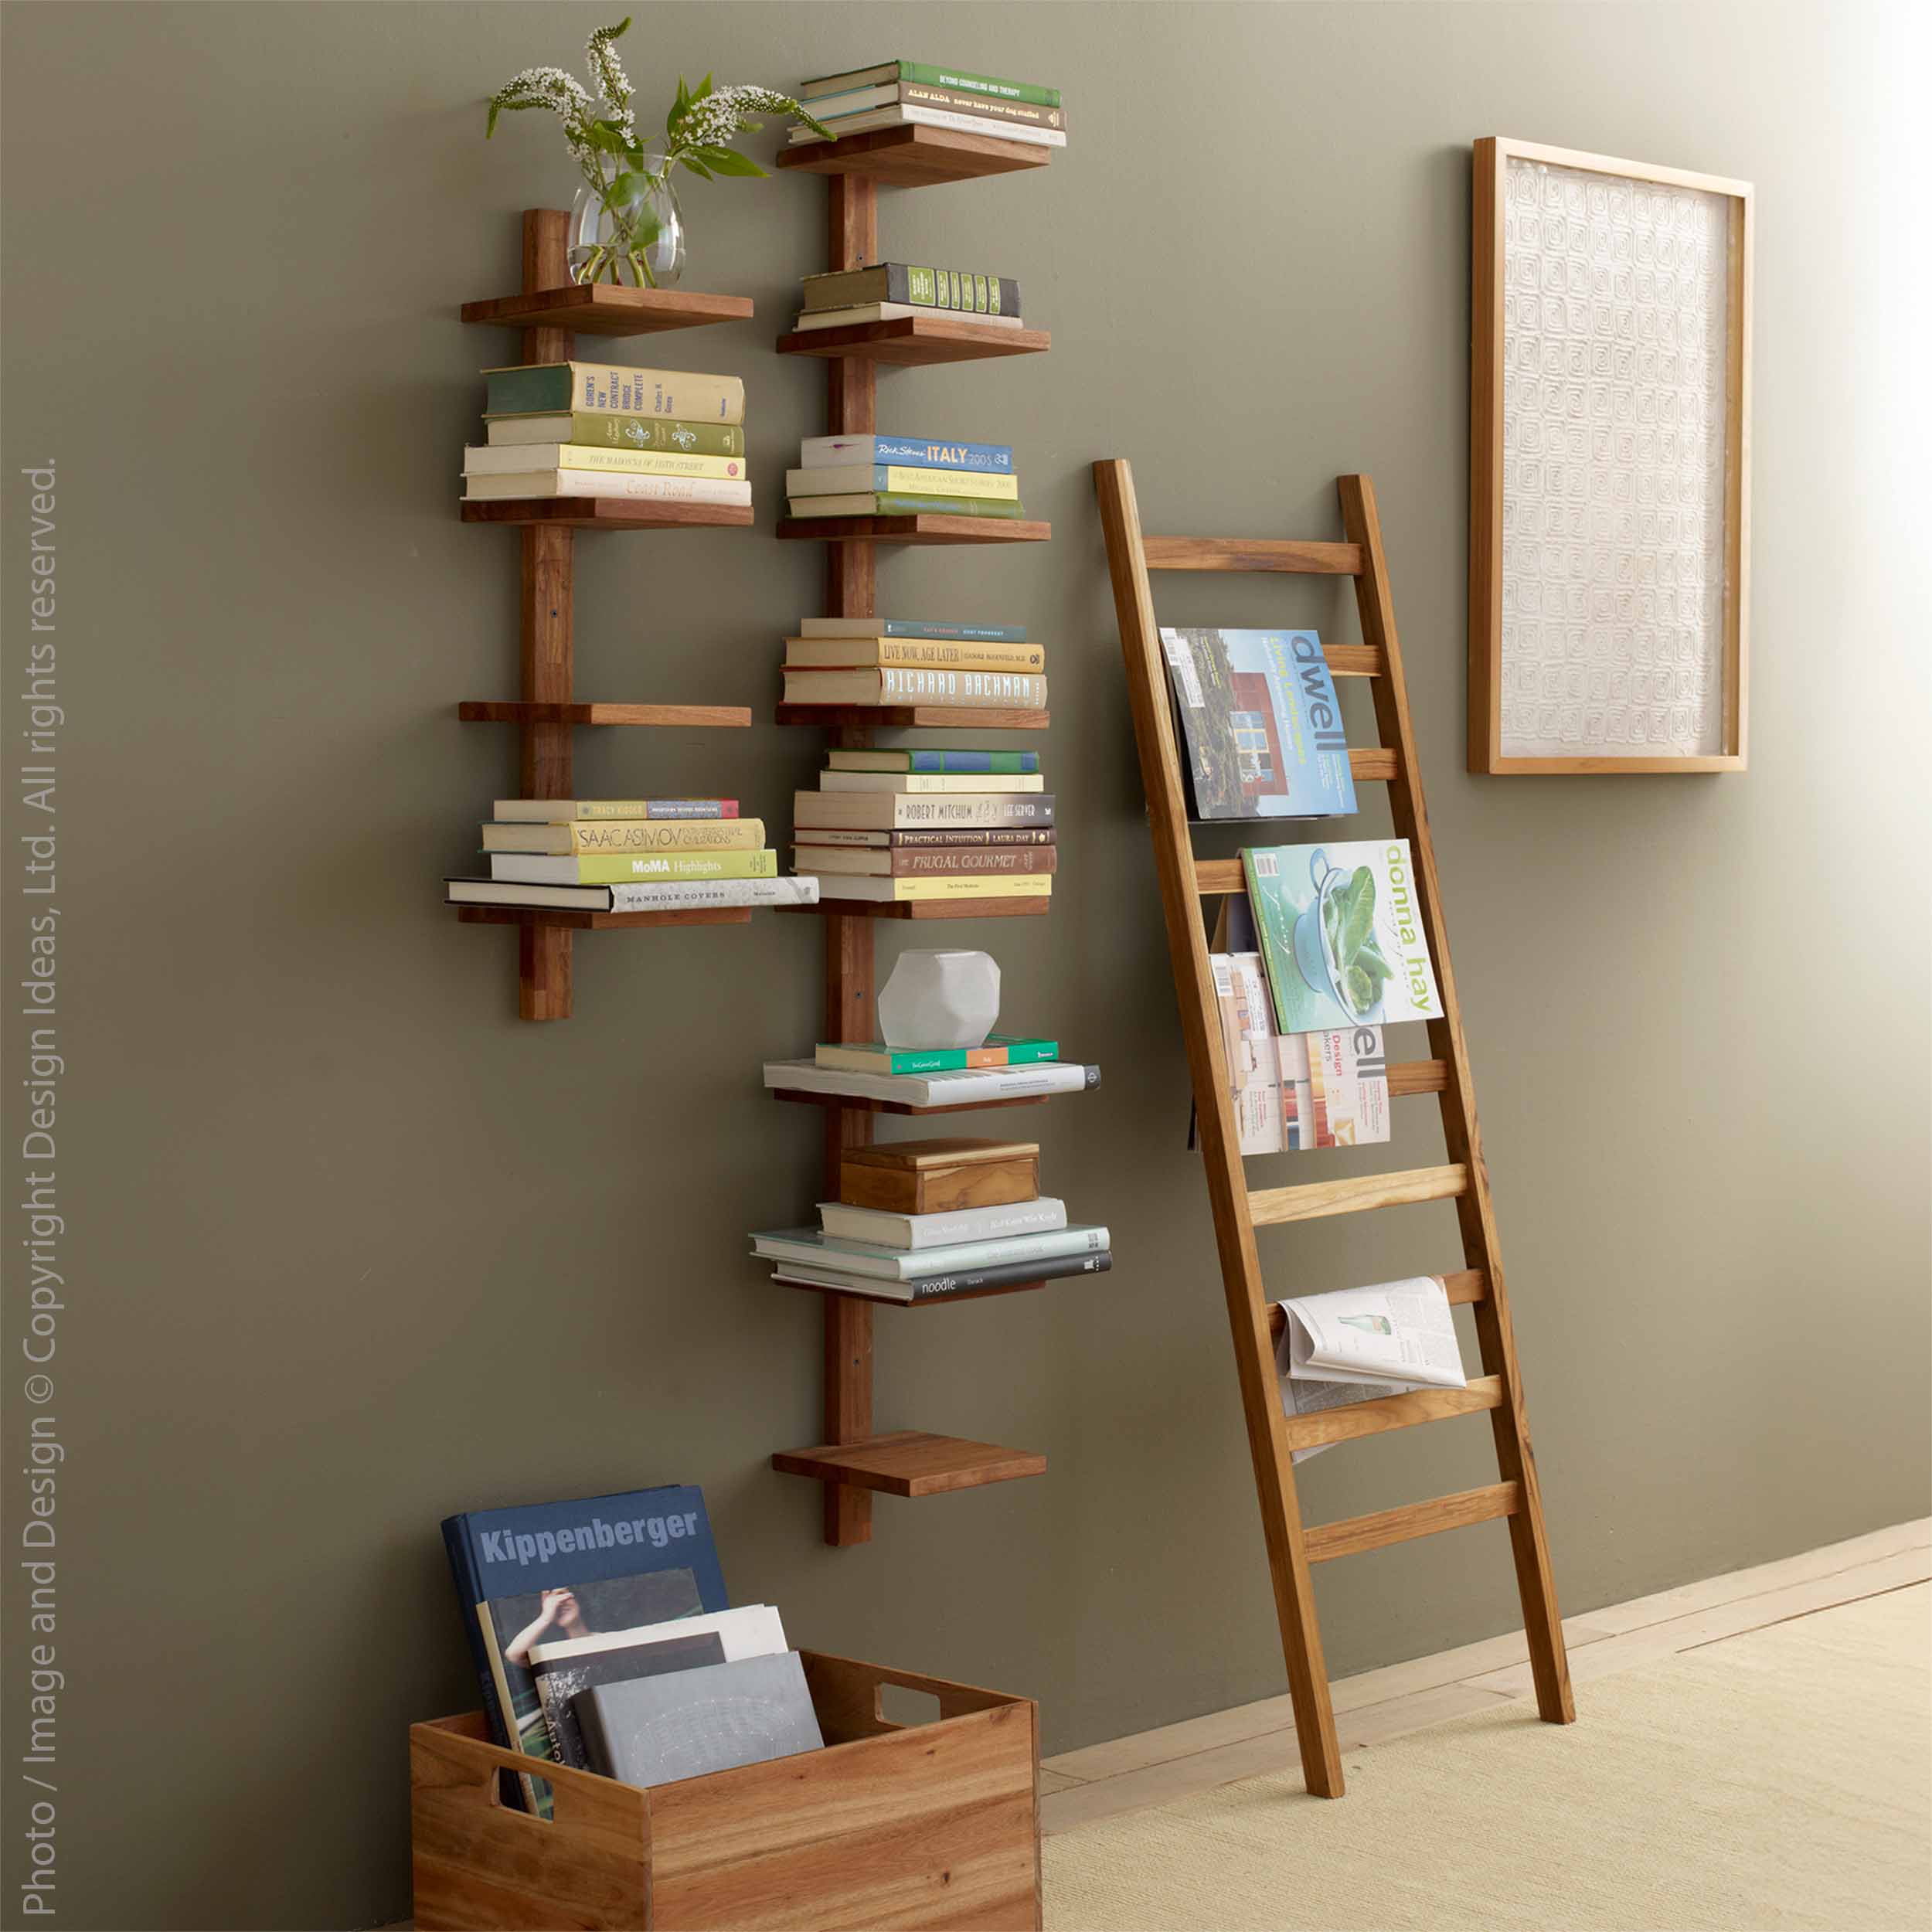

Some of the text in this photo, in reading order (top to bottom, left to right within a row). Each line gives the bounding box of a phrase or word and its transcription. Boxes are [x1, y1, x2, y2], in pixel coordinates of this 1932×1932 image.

[908, 89, 929, 100] ALAN
[930, 93, 950, 103] ALDA
[954, 98, 972, 108] never
[973, 100, 989, 111] have
[989, 104, 1005, 113] your
[1005, 107, 1016, 116] dog
[586, 376, 595, 406] GOREN'S
[610, 371, 619, 409] CONTRACT
[622, 384, 631, 410] BRIDGE
[634, 373, 643, 410] COMPLETE
[927, 446, 968, 464] ITALY
[624, 479, 658, 495] Coast
[884, 645, 900, 660] LIVE
[920, 646, 934, 662] AGE
[937, 647, 960, 662] LATER
[886, 669, 957, 695] RICHARD
[964, 673, 1031, 699] BACHMAN
[1291, 635, 1348, 751] dwell
[906, 804, 936, 821] ROBERT
[937, 803, 973, 820] MITCHUM
[623, 828, 682, 847] ASIMOV
[904, 834, 943, 844] PRACTICAL
[945, 833, 984, 843] INTUITION
[632, 859, 723, 875] MoMA Highlights
[913, 855, 959, 869] FRUGAL
[962, 855, 1017, 868] GOURMET
[626, 892, 680, 903] MANHOLE
[684, 891, 726, 900] COVERS
[1386, 845, 1417, 946] donna
[1406, 957, 1432, 1013] hay
[1323, 1031, 1332, 1063] akers
[1332, 1034, 1342, 1077] Design
[1354, 1027, 1386, 1079] ell
[921, 1277, 957, 1294] noodle
[481, 1511, 698, 1566] Kippenberger
